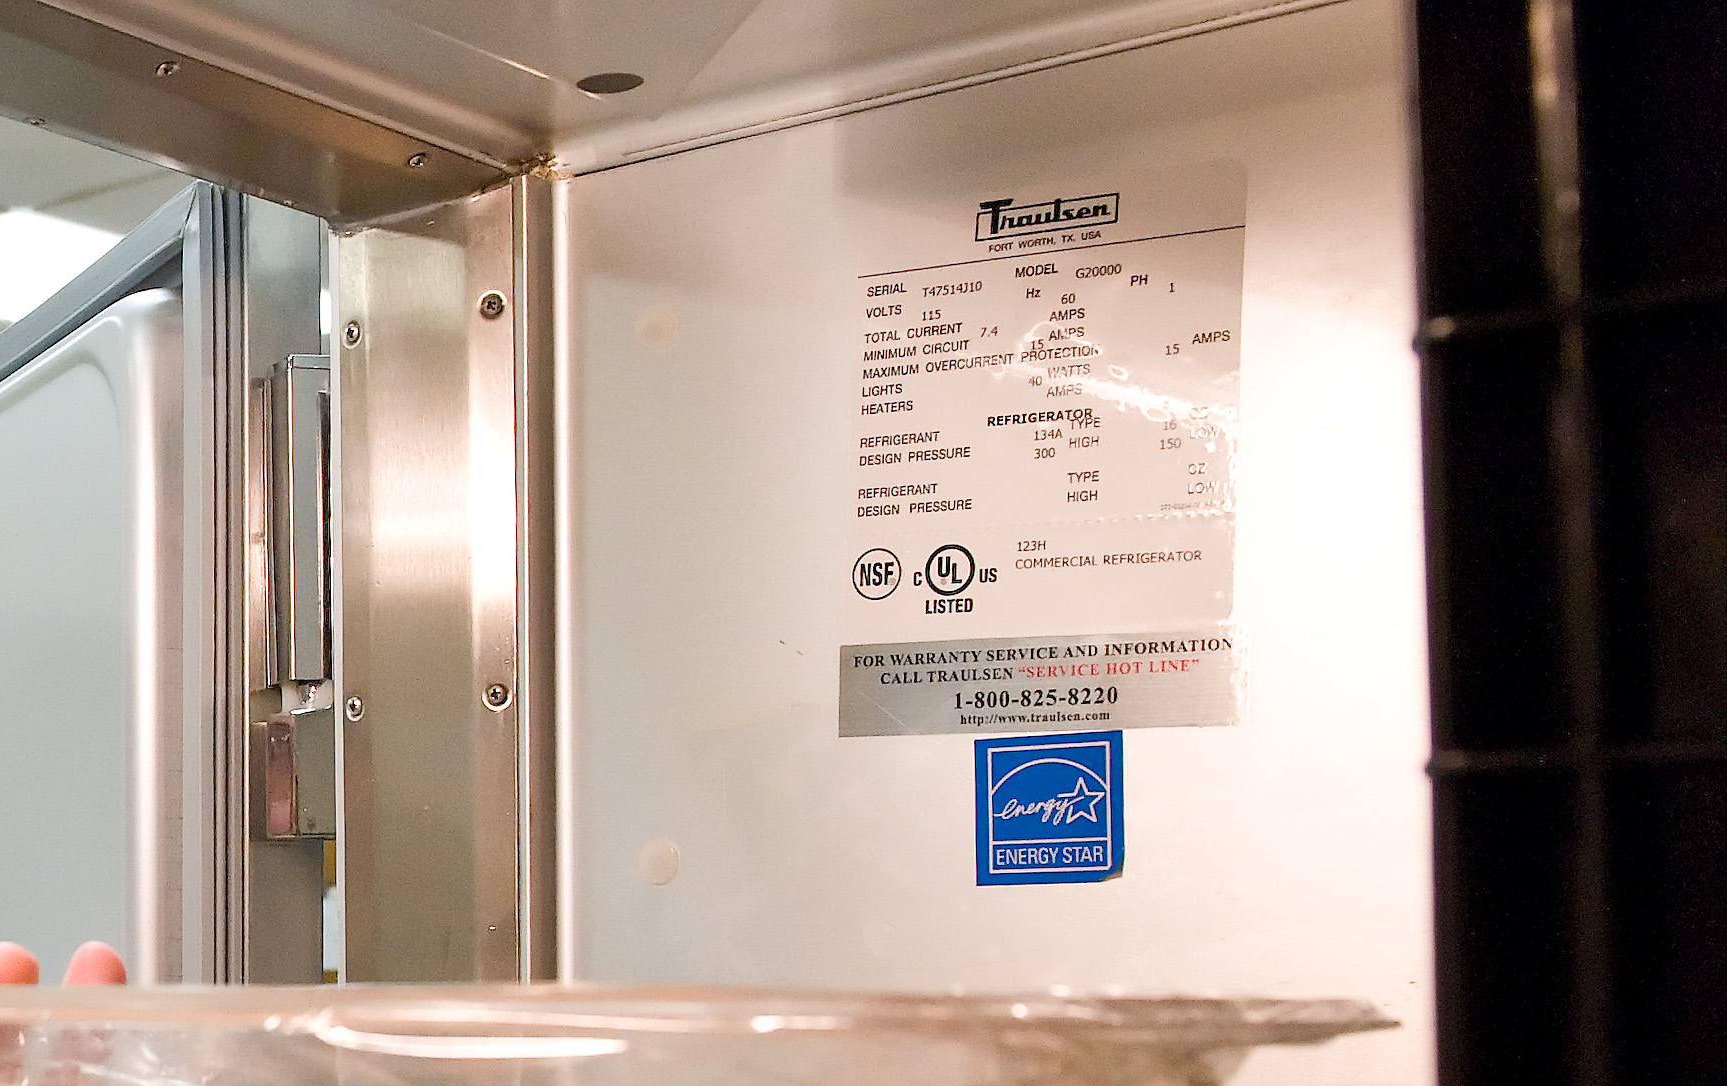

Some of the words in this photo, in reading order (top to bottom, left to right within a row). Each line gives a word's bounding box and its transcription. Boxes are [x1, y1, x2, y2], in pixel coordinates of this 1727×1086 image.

[979, 198, 1110, 234] Traulsen
[988, 241, 1014, 253] FORT
[1018, 237, 1056, 249] WORTH,
[1081, 230, 1102, 241] USA
[866, 282, 908, 298] SERIAL
[921, 281, 983, 299] T47514J10
[1015, 264, 1059, 278] MODEL
[1075, 264, 1122, 279] G20000
[865, 304, 903, 319] VOLTS
[921, 309, 942, 322] 115
[1025, 287, 1041, 299] Hz
[1061, 293, 1076, 305] 60
[1130, 274, 1149, 286] PH
[1169, 282, 1175, 293] 1
[864, 329, 901, 344] TOTAL
[906, 322, 963, 341] CURRENT
[980, 326, 998, 338] 7.4
[1049, 307, 1086, 322] AMPS
[862, 364, 919, 380] MAXIMUM
[925, 353, 1014, 373] OVERCURRENT
[1020, 345, 1099, 363] PROTECTION
[1165, 343, 1180, 356] 15
[1192, 329, 1231, 345] AMPS
[863, 346, 917, 362] MINIMUM
[923, 339, 970, 356] CIRCUIT
[1030, 338, 1044, 350] 15
[1048, 327, 1085, 342] AMPS
[861, 383, 903, 398] LIGHTS
[1028, 375, 1043, 387] 40
[1047, 364, 1091, 379] WATTS
[861, 400, 914, 415] HEATERS
[1046, 382, 1083, 398] AMPS
[987, 408, 1094, 427] REFRIGERATOR
[859, 453, 902, 467] DESIGN
[908, 447, 971, 463] PRESSURE
[1033, 448, 1056, 460] 300
[1068, 436, 1100, 449] HIGH
[1159, 438, 1182, 450] 150
[1189, 426, 1220, 440] LOW
[860, 431, 940, 449] REFRIGERANT
[1033, 429, 1063, 442] 134A
[1068, 416, 1101, 430] TYPE
[1163, 419, 1178, 431] 16
[857, 483, 938, 500] REFRIGERANT
[1067, 470, 1100, 484] TYPE
[1188, 463, 1207, 475] OZ
[857, 504, 900, 518] DESIGN
[909, 499, 973, 515] PRESSURE
[1067, 490, 1098, 503] HIGH
[1015, 555, 1098, 570] COMMERCIAL
[1103, 550, 1202, 565] REFRIGERATOR
[1016, 540, 1047, 552] 123H
[859, 562, 894, 587] NSF
[937, 556, 962, 585] UL
[979, 568, 998, 583] US
[925, 598, 974, 615] LISTED
[854, 655, 885, 668] FOR
[890, 650, 981, 667] WARRANTY
[986, 646, 1058, 662] SERVICE
[1063, 644, 1098, 658] AND
[1104, 638, 1233, 656] INFORMATION
[880, 671, 923, 685] CALL
[926, 667, 1014, 683] TRAULSEN
[1106, 661, 1143, 675] HOT
[954, 686, 1118, 710] 1-800-825-8220
[960, 711, 1110, 727] http://www.traulsen.com
[996, 847, 1058, 866] ENERGY
[1062, 845, 1104, 864] STAR
